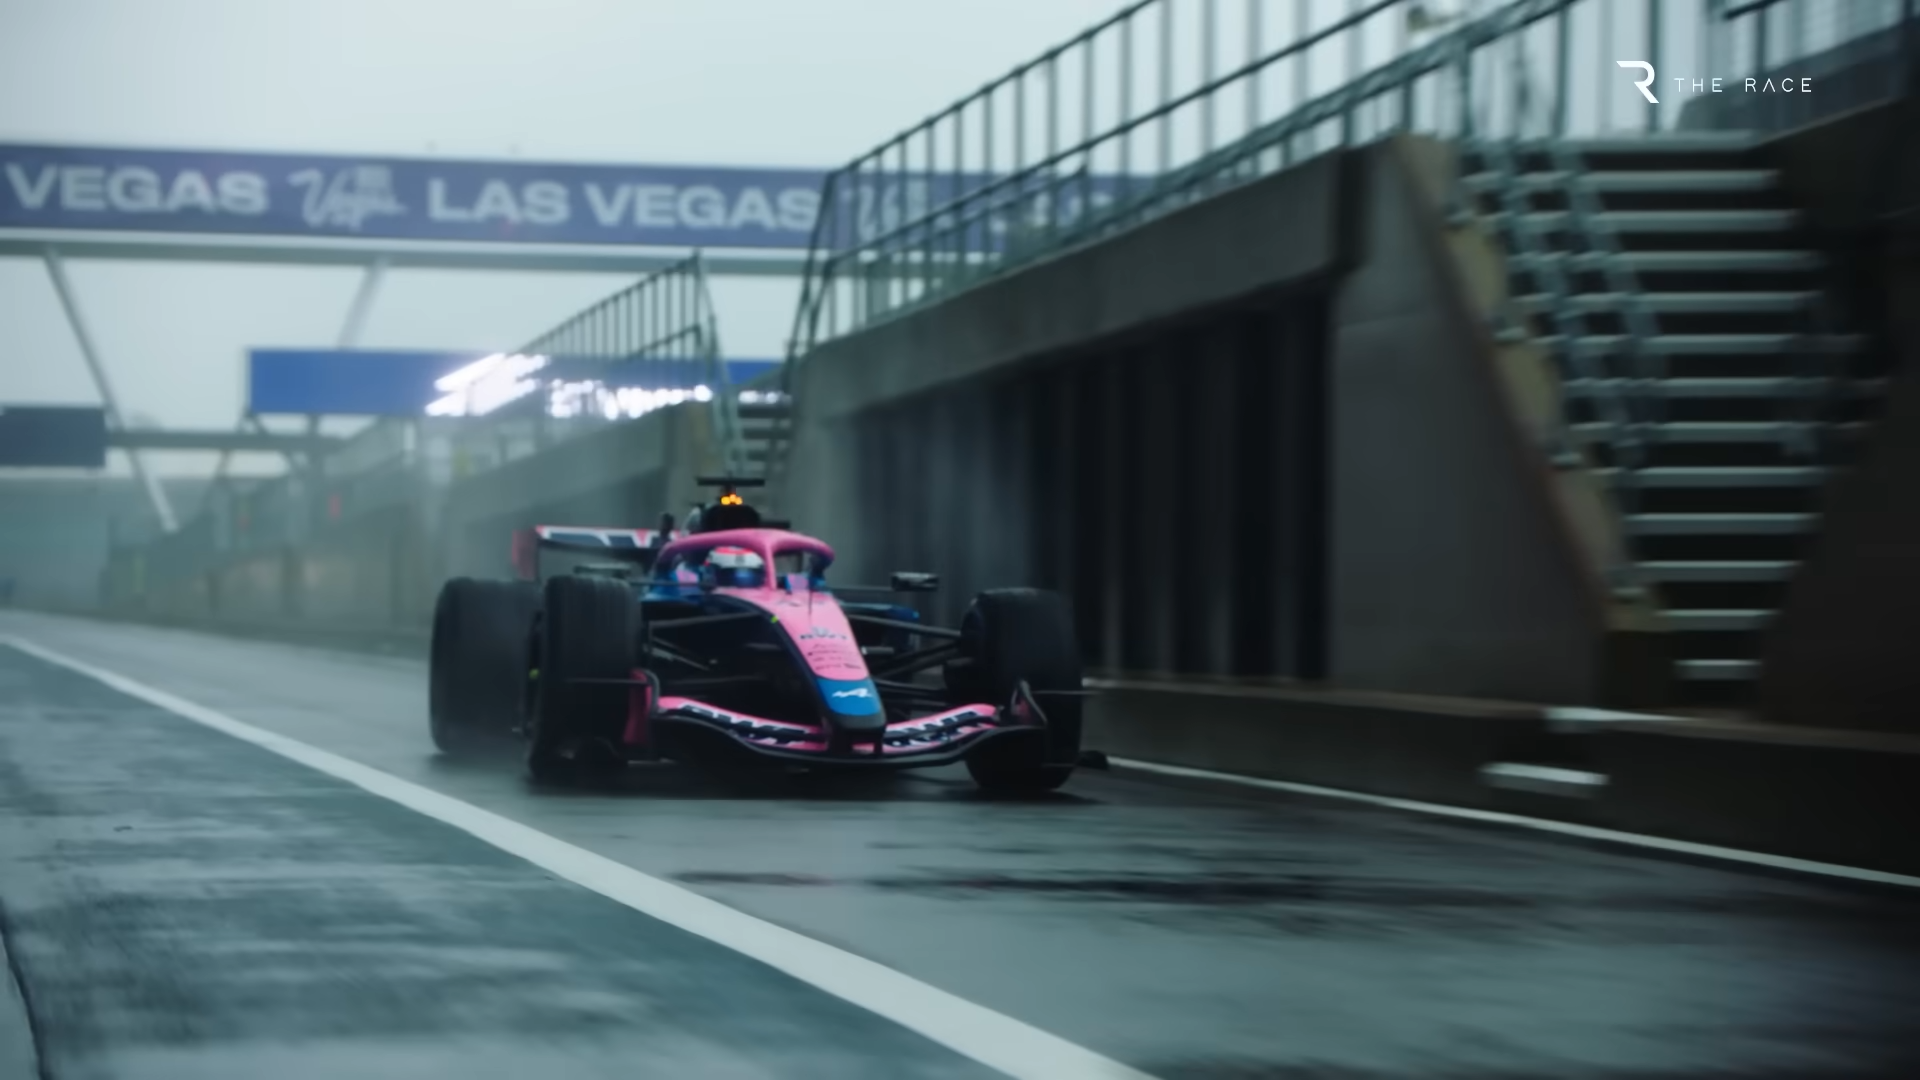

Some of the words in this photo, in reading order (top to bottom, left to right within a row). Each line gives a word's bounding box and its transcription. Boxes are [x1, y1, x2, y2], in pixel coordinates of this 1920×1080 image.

[6, 164, 269, 213] VEGAS
[428, 178, 569, 226] LAS
[584, 184, 820, 231] VEGAS
